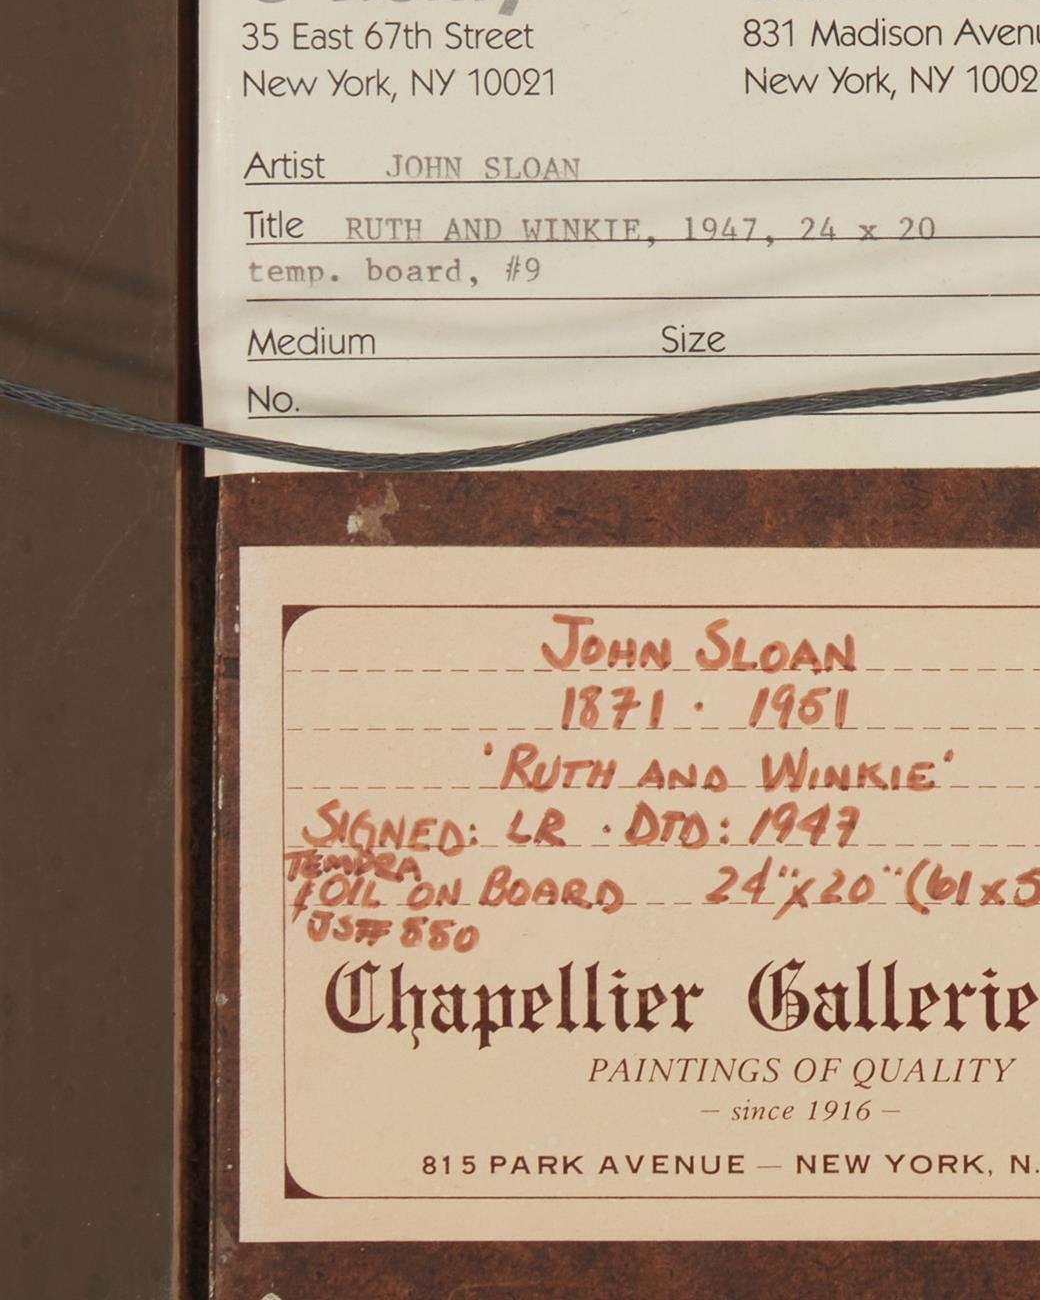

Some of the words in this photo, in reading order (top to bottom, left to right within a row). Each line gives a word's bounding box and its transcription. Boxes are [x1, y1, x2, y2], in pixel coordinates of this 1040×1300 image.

[241, 22, 279, 51] 35
[292, 22, 354, 51] East
[363, 21, 433, 50] 67th
[444, 21, 534, 50] Street
[743, 18, 794, 47] 831
[810, 17, 943, 47] Madison
[242, 68, 318, 97] New
[327, 67, 398, 104] York,
[411, 68, 456, 97] NY
[467, 67, 555, 96] 10021
[744, 65, 820, 95] New
[827, 65, 897, 101] York,
[910, 65, 955, 94] NY
[243, 150, 326, 180] Artist
[384, 154, 463, 180] JOHN
[484, 156, 582, 180] SLOAN
[243, 209, 305, 240] Title
[345, 217, 423, 241] RUTH
[443, 217, 503, 242] AND
[521, 216, 657, 249] WINKIE,
[683, 216, 775, 249] 1947,
[799, 216, 837, 241] 24
[859, 223, 879, 241] x
[898, 216, 937, 240] 20
[248, 260, 341, 287] temp.
[366, 257, 479, 288] board,
[505, 254, 541, 283] #9
[247, 326, 376, 356] Medium
[660, 324, 727, 354] Size
[247, 384, 301, 414] No.
[541, 613, 673, 670] JOHN
[695, 617, 857, 675] SLOAN
[561, 685, 665, 731] 1871
[748, 683, 850, 730] 1951
[636, 757, 729, 793] AND
[301, 797, 480, 858] SIGNED:
[505, 806, 567, 847] LR
[623, 799, 731, 850] DTD:
[747, 801, 862, 847] 1947
[406, 876, 463, 912] ON
[477, 864, 626, 915] BOARD
[324, 958, 706, 1051] Chapellier
[587, 1056, 782, 1084] PAINTINGS
[792, 1056, 843, 1084] OF
[851, 1056, 1018, 1090] QUALITY
[731, 1099, 796, 1122] since
[806, 1098, 873, 1123] 1916
[421, 1155, 479, 1176] 815
[489, 1154, 585, 1175] PARK
[598, 1154, 747, 1175] AVENUE
[795, 1153, 872, 1175] NEW
[884, 1153, 994, 1178] YORK,
